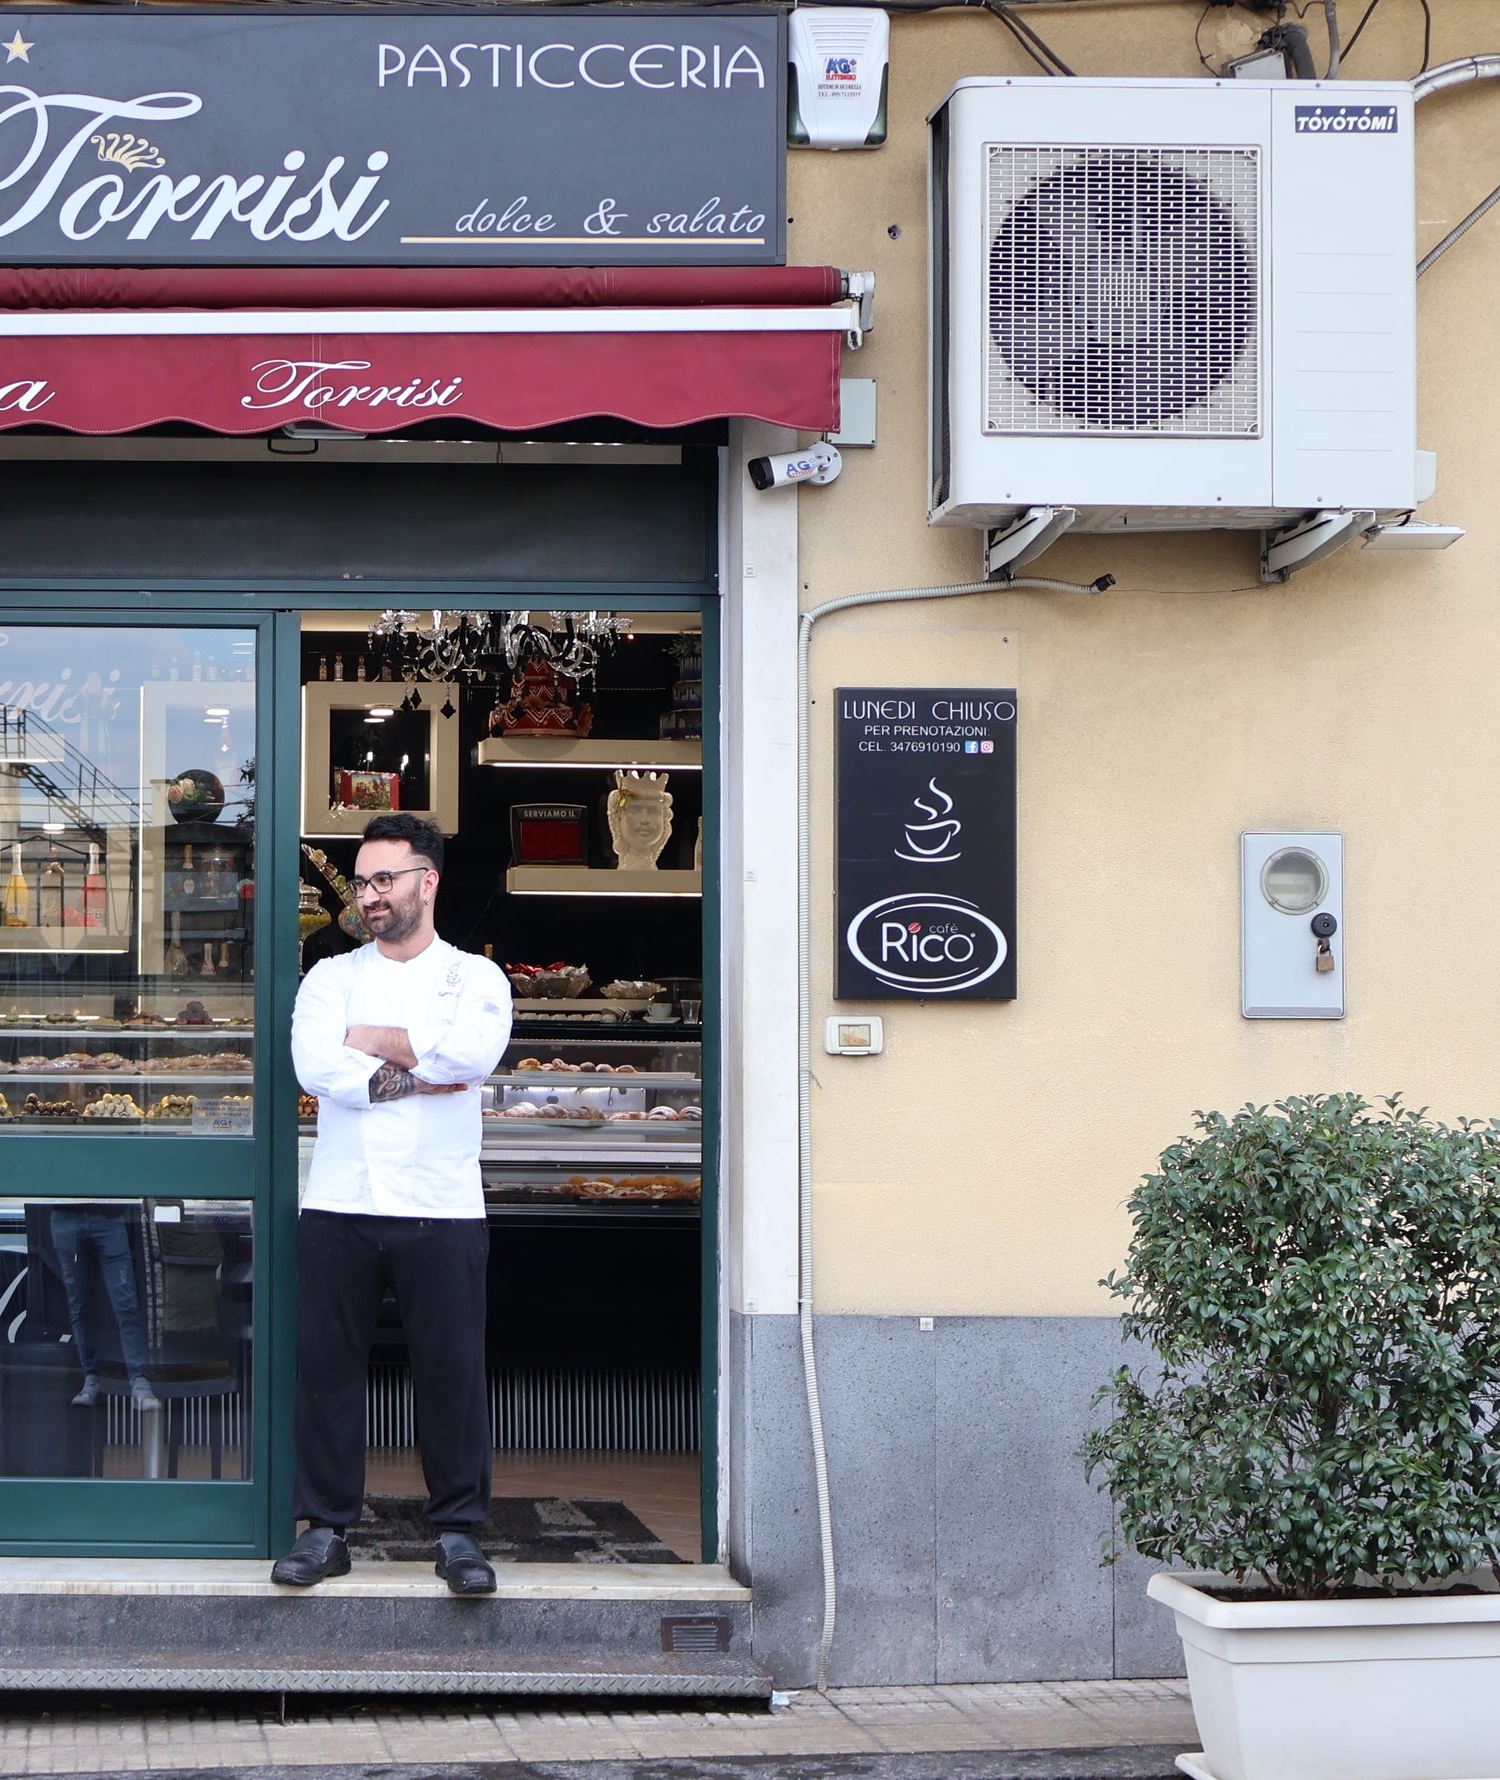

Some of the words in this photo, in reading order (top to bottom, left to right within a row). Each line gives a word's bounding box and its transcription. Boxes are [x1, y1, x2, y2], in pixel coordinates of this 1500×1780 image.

[378, 43, 765, 89] PASTICCERIA
[1297, 107, 1396, 131] TOYOTOMI
[455, 195, 557, 233] dolce
[583, 198, 629, 235] &
[646, 196, 766, 234] salato
[241, 359, 463, 409] Torrisi
[844, 700, 916, 720] LUNEDI
[931, 701, 1016, 721] CHIUSO
[864, 724, 891, 736] PER
[893, 725, 991, 737] PRENOTAZIONI:
[858, 741, 887, 752] CEL.
[890, 741, 961, 753] 3476910190
[524, 810, 567, 818] SERVIAMO
